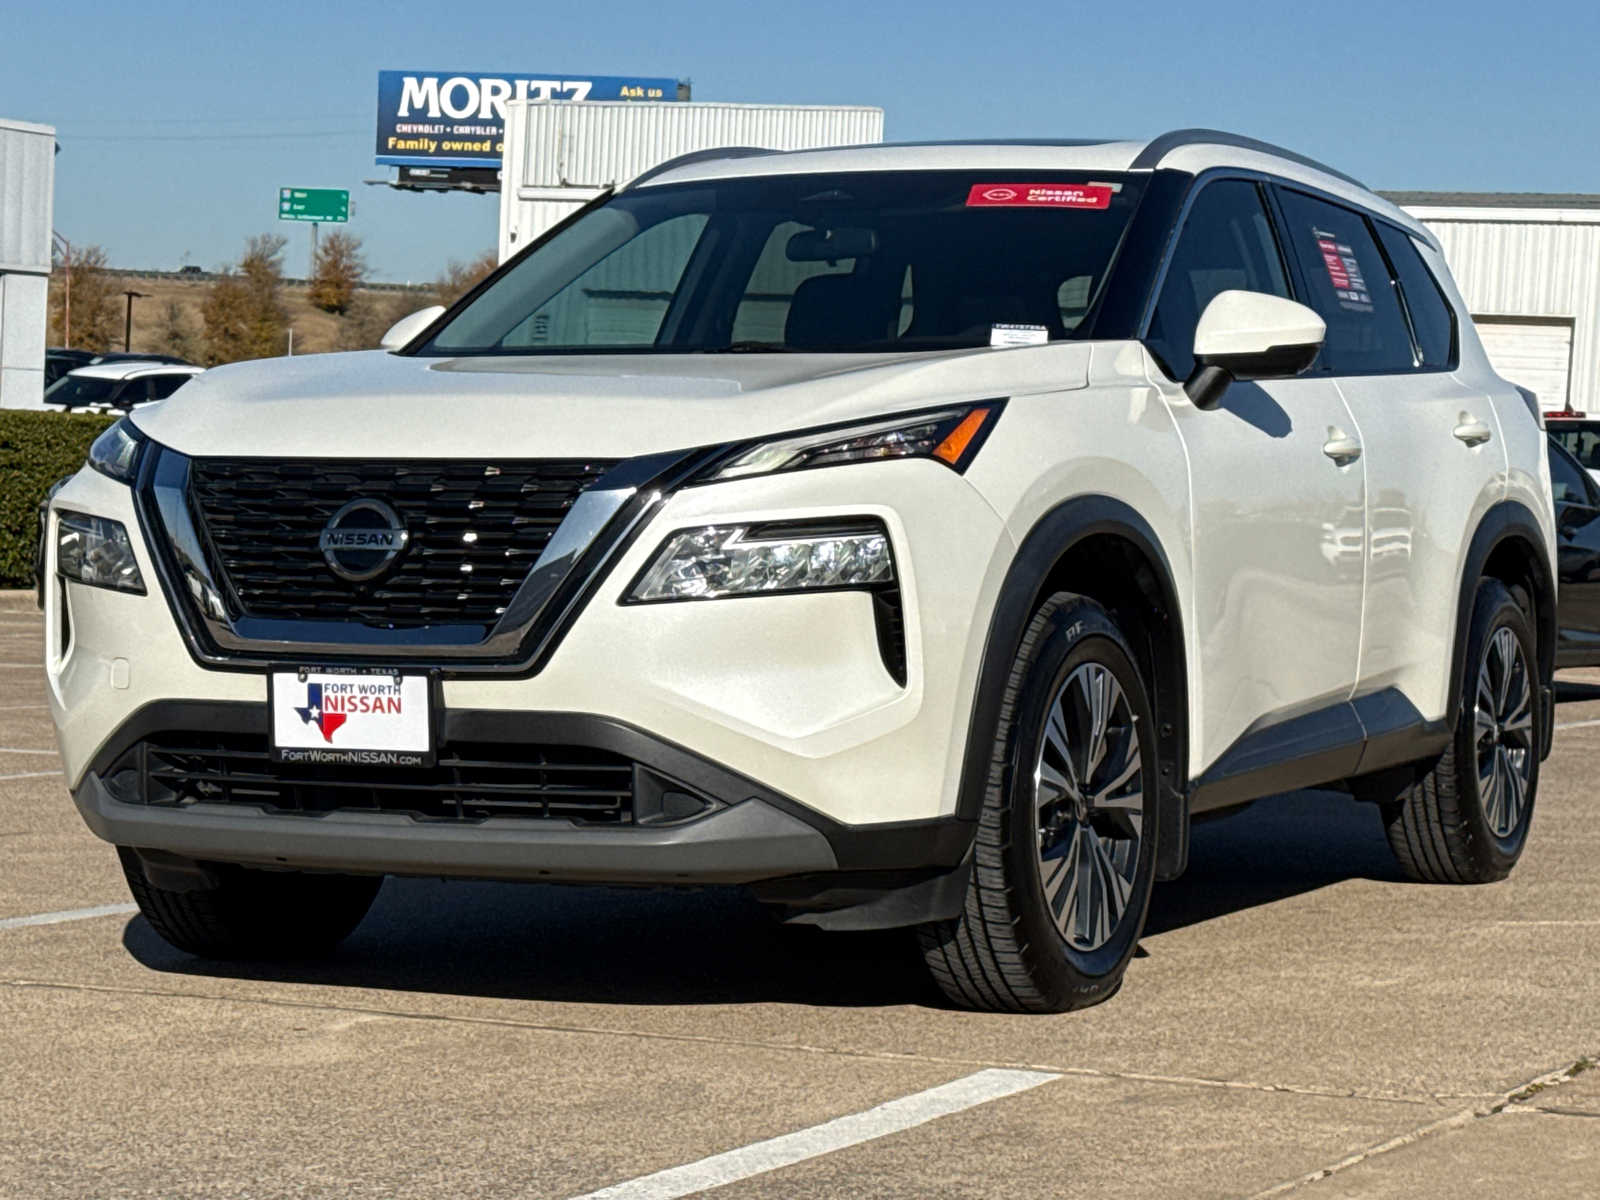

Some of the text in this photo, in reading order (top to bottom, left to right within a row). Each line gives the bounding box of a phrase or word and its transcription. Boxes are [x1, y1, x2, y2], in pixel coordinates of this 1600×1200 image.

[620, 85, 663, 98] Ask us
[395, 123, 497, 135] CHEVROLET CHRYSLER
[387, 136, 438, 153] Family
[441, 140, 491, 152] owned
[1027, 195, 1098, 203] Certified
[1029, 188, 1084, 197] Nissan
[326, 533, 395, 546] NISSAN
[299, 666, 399, 676] FORT WORTH TEXAS
[324, 683, 401, 696] FORT WORTH
[324, 694, 402, 714] NISSAN
